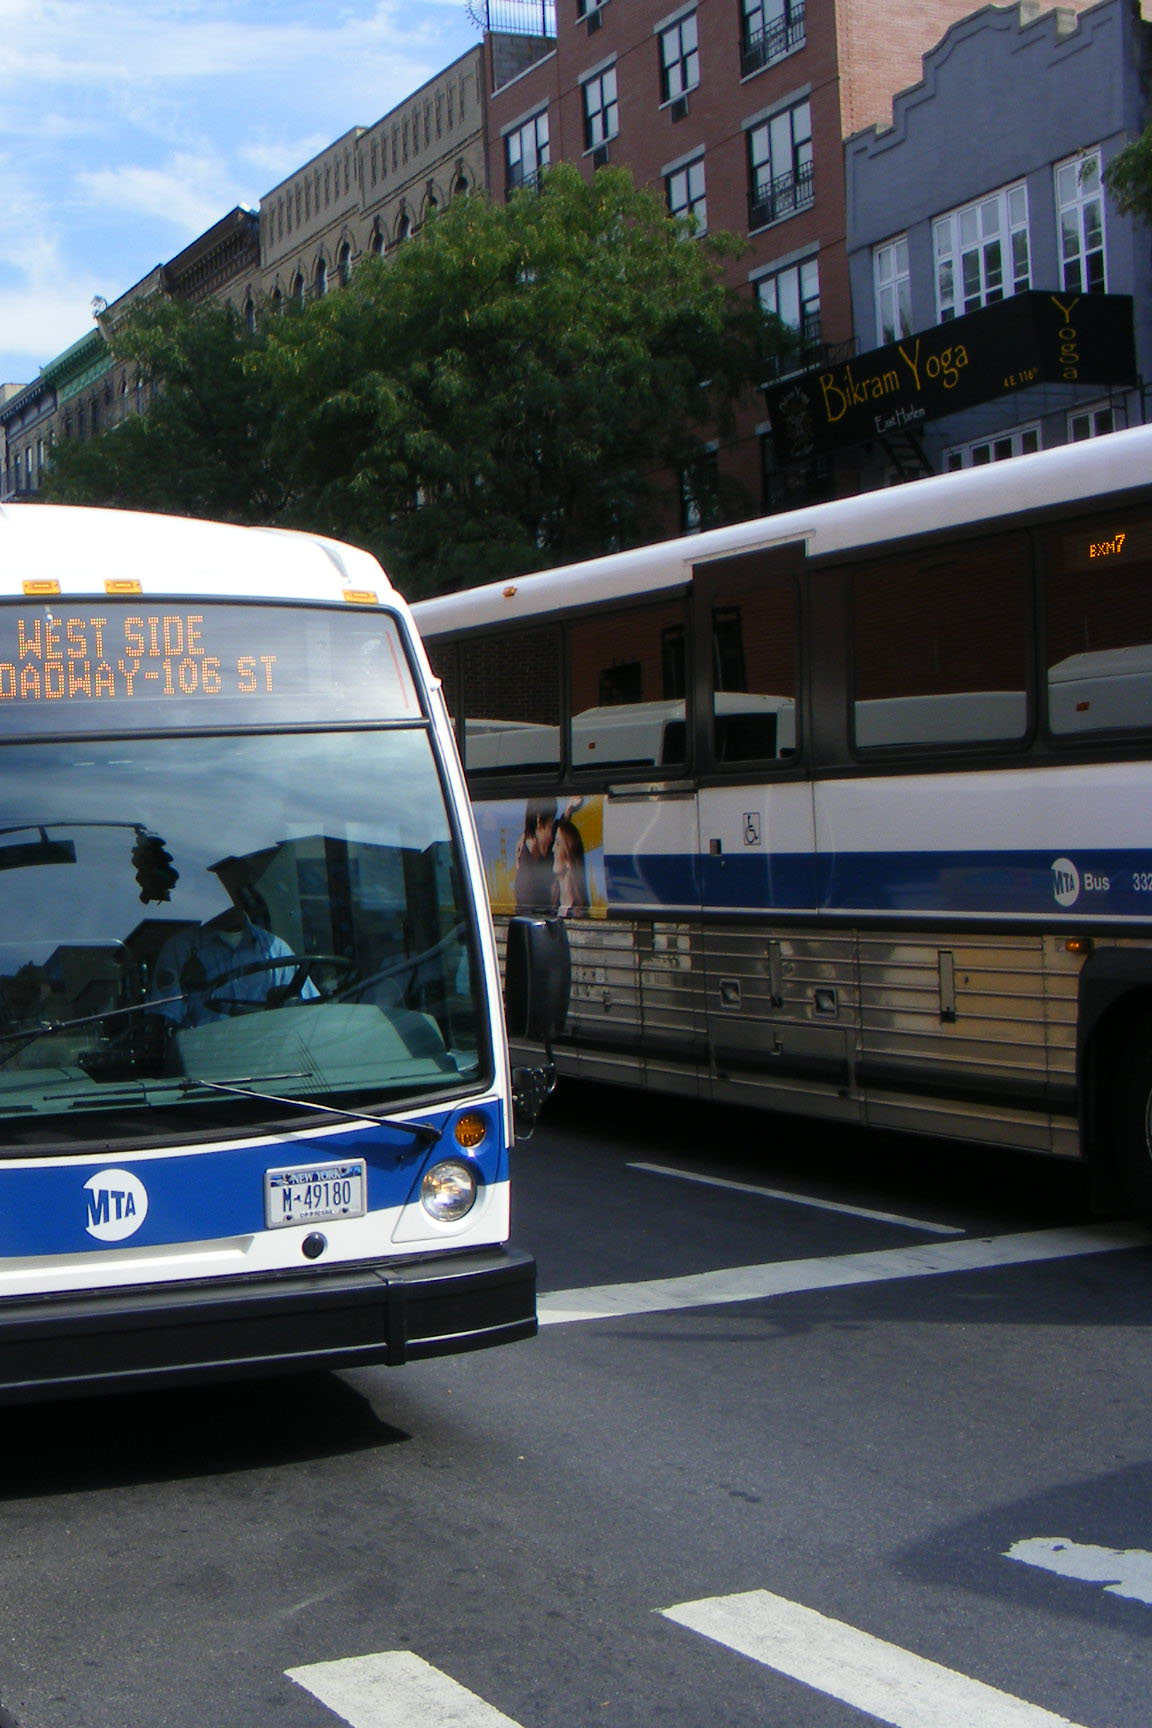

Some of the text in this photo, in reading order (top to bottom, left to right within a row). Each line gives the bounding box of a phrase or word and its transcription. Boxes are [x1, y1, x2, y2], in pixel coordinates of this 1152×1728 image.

[1050, 296, 1080, 379] Yoga
[819, 365, 900, 423] Bikram
[899, 338, 969, 391] Yoga
[18, 615, 206, 660] WEST SIDE
[238, 655, 277, 692] ST
[1084, 873, 1111, 890] Bus
[85, 1188, 136, 1227] MTA
